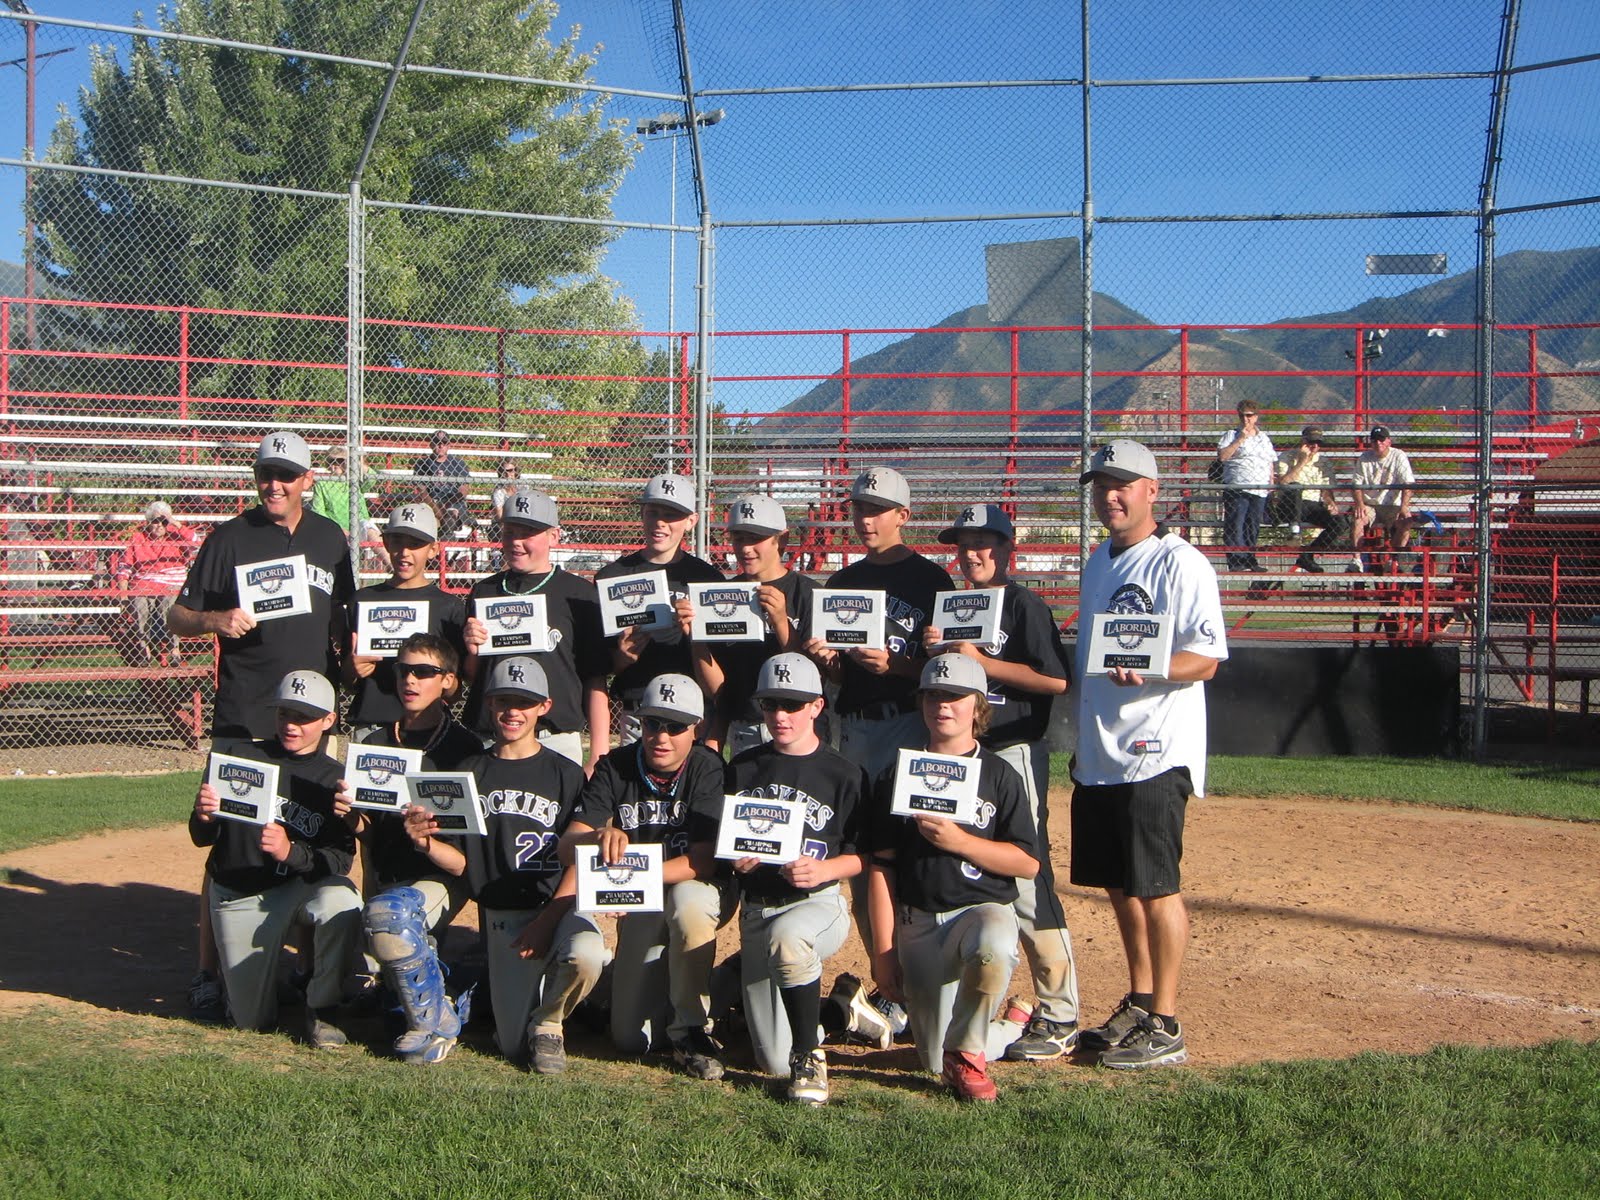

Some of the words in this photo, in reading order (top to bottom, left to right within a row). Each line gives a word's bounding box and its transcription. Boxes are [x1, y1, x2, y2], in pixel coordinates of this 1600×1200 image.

[248, 565, 293, 584] LABORDAY
[610, 581, 655, 599] LABORDAY
[701, 592, 748, 605] LABORDAY
[825, 599, 872, 611] LABORDAY
[945, 597, 990, 610] LABORDAY
[370, 609, 416, 621] LABORDAY
[488, 604, 533, 618] LABORDAY
[1106, 622, 1160, 636] LABORDAY
[359, 756, 407, 774] LABORDAY
[911, 761, 967, 780] LABORDAY
[221, 766, 264, 787] LABORDAY
[418, 783, 462, 796] LABORDAY
[737, 805, 789, 822] LABORDAY
[593, 856, 648, 871] LRDAY
